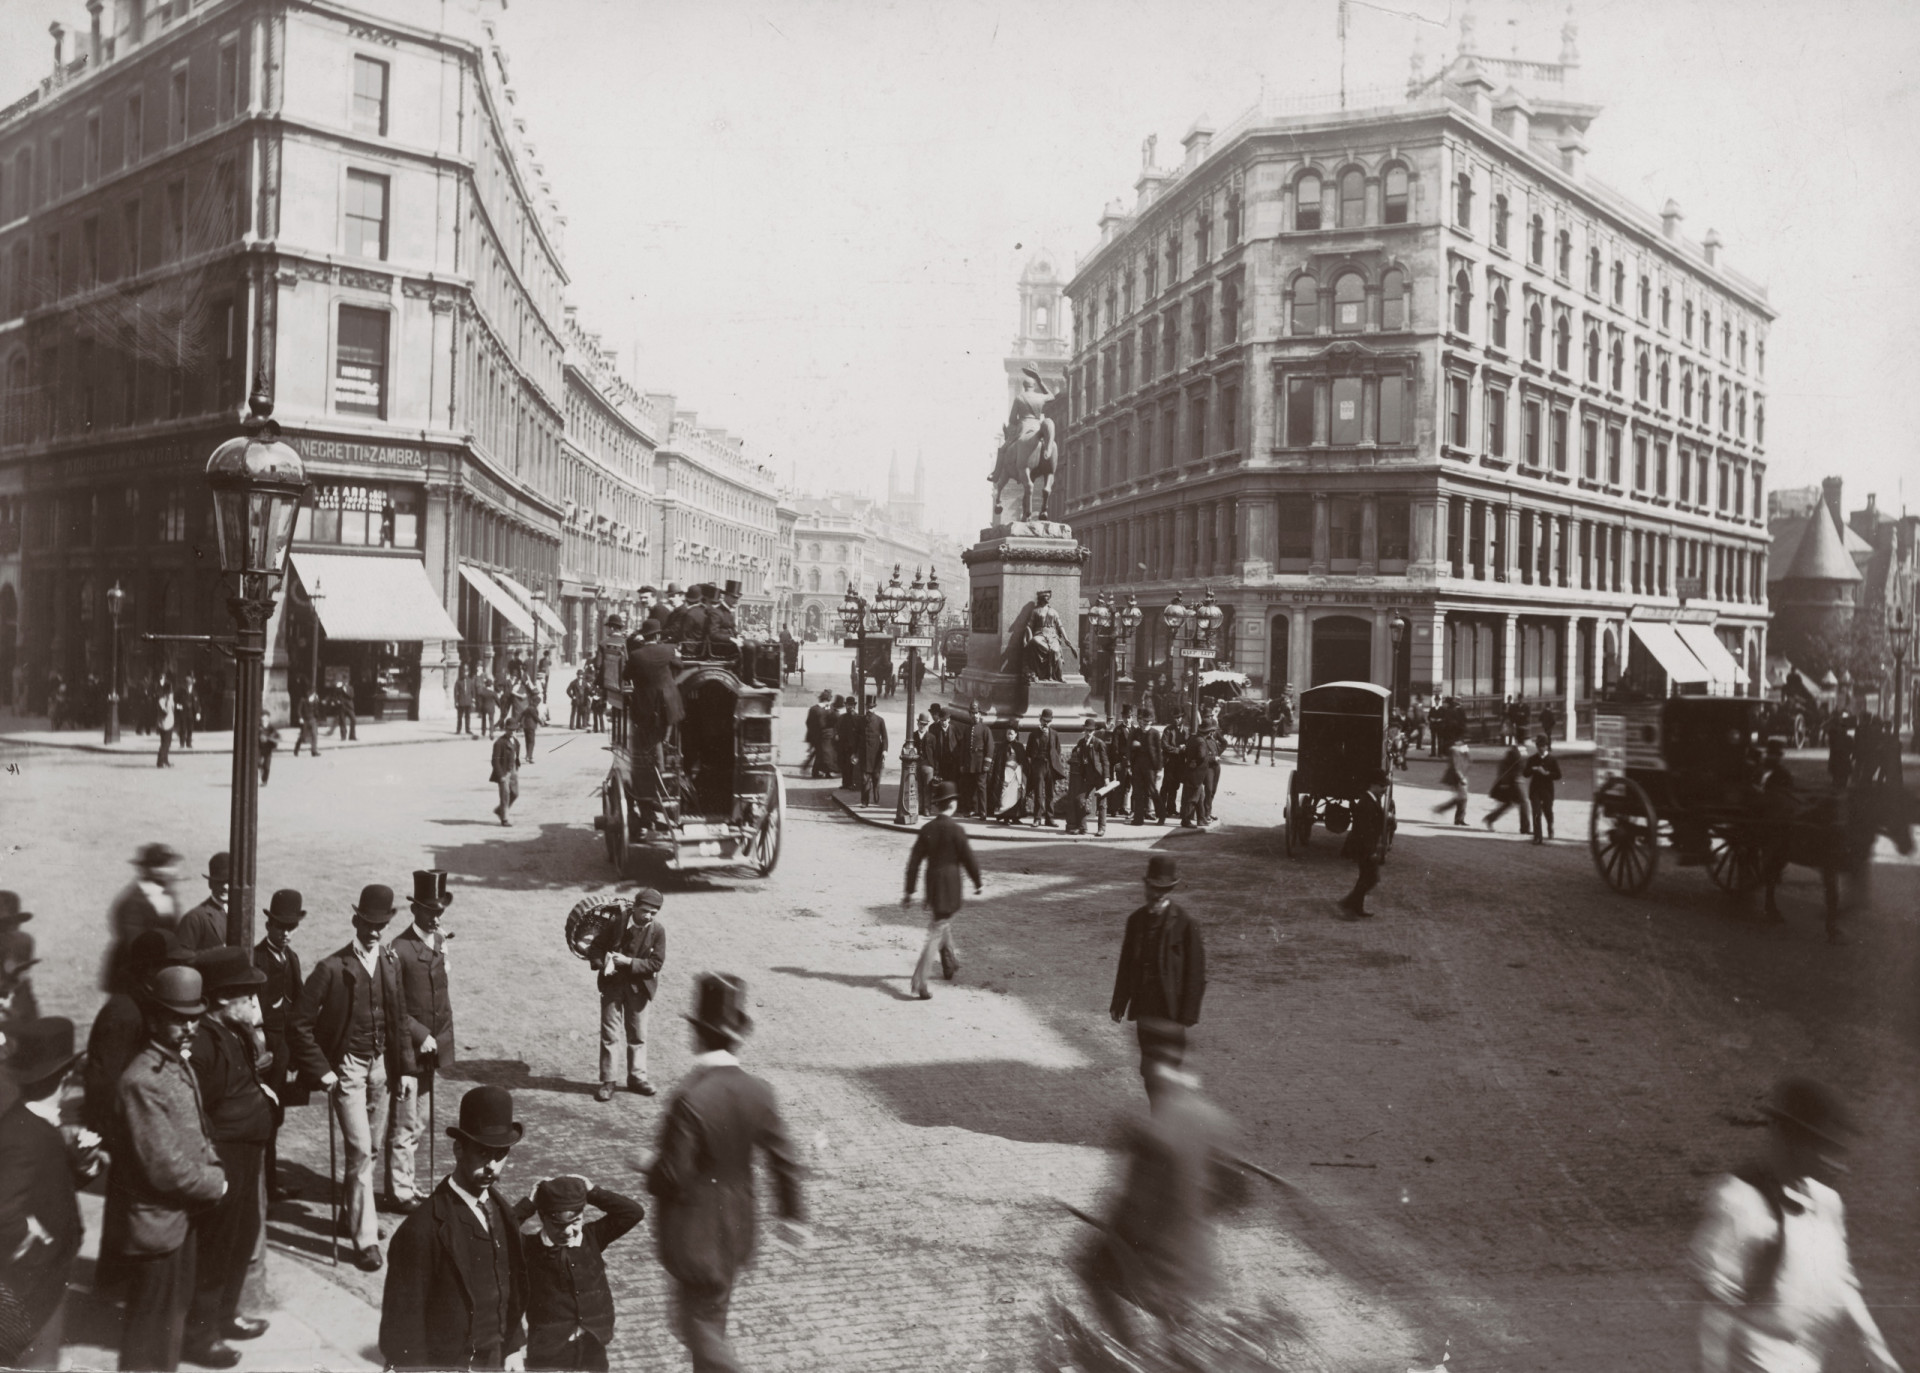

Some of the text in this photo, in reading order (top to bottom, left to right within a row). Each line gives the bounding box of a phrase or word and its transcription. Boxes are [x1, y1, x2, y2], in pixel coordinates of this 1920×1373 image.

[300, 439, 363, 460] NEGRETTI
[369, 446, 422, 466] ZAMBRA
[1258, 592, 1282, 601] THE
[1292, 592, 1324, 602] CITY
